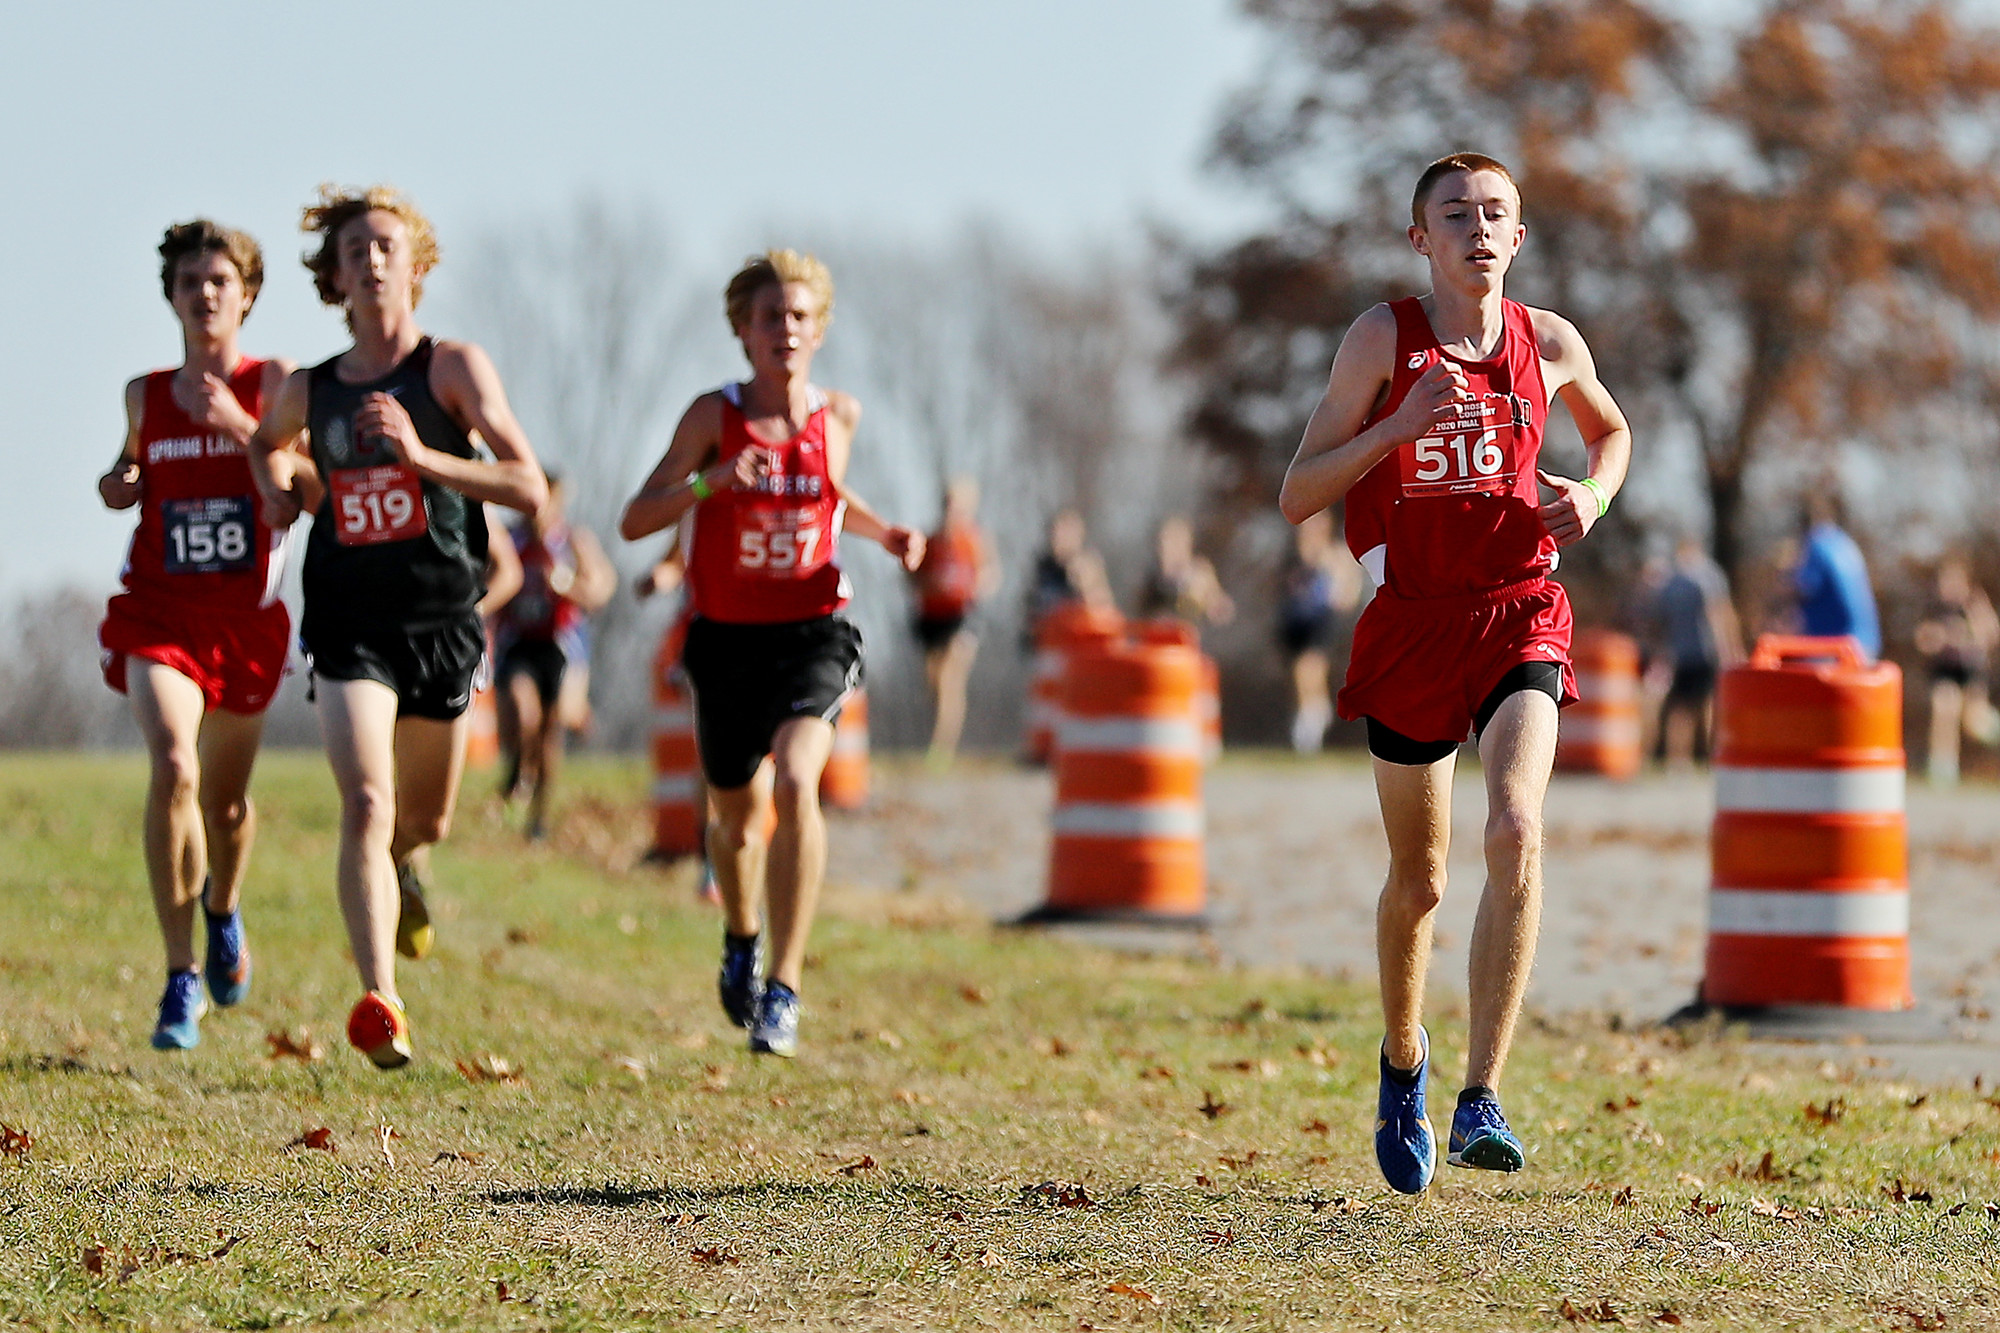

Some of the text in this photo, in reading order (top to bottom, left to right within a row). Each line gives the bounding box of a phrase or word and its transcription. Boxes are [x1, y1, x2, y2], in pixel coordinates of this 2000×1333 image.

[1459, 407, 1496, 419] COUNTRY
[1464, 401, 1487, 411] ROSS
[1435, 419, 1480, 431] 2020 FINAL
[147, 435, 203, 465] SPRING
[1415, 429, 1504, 481] 516
[732, 474, 821, 496] NGERS
[341, 489, 414, 534] 519
[170, 522, 247, 563] 158
[739, 528, 821, 569] 557
